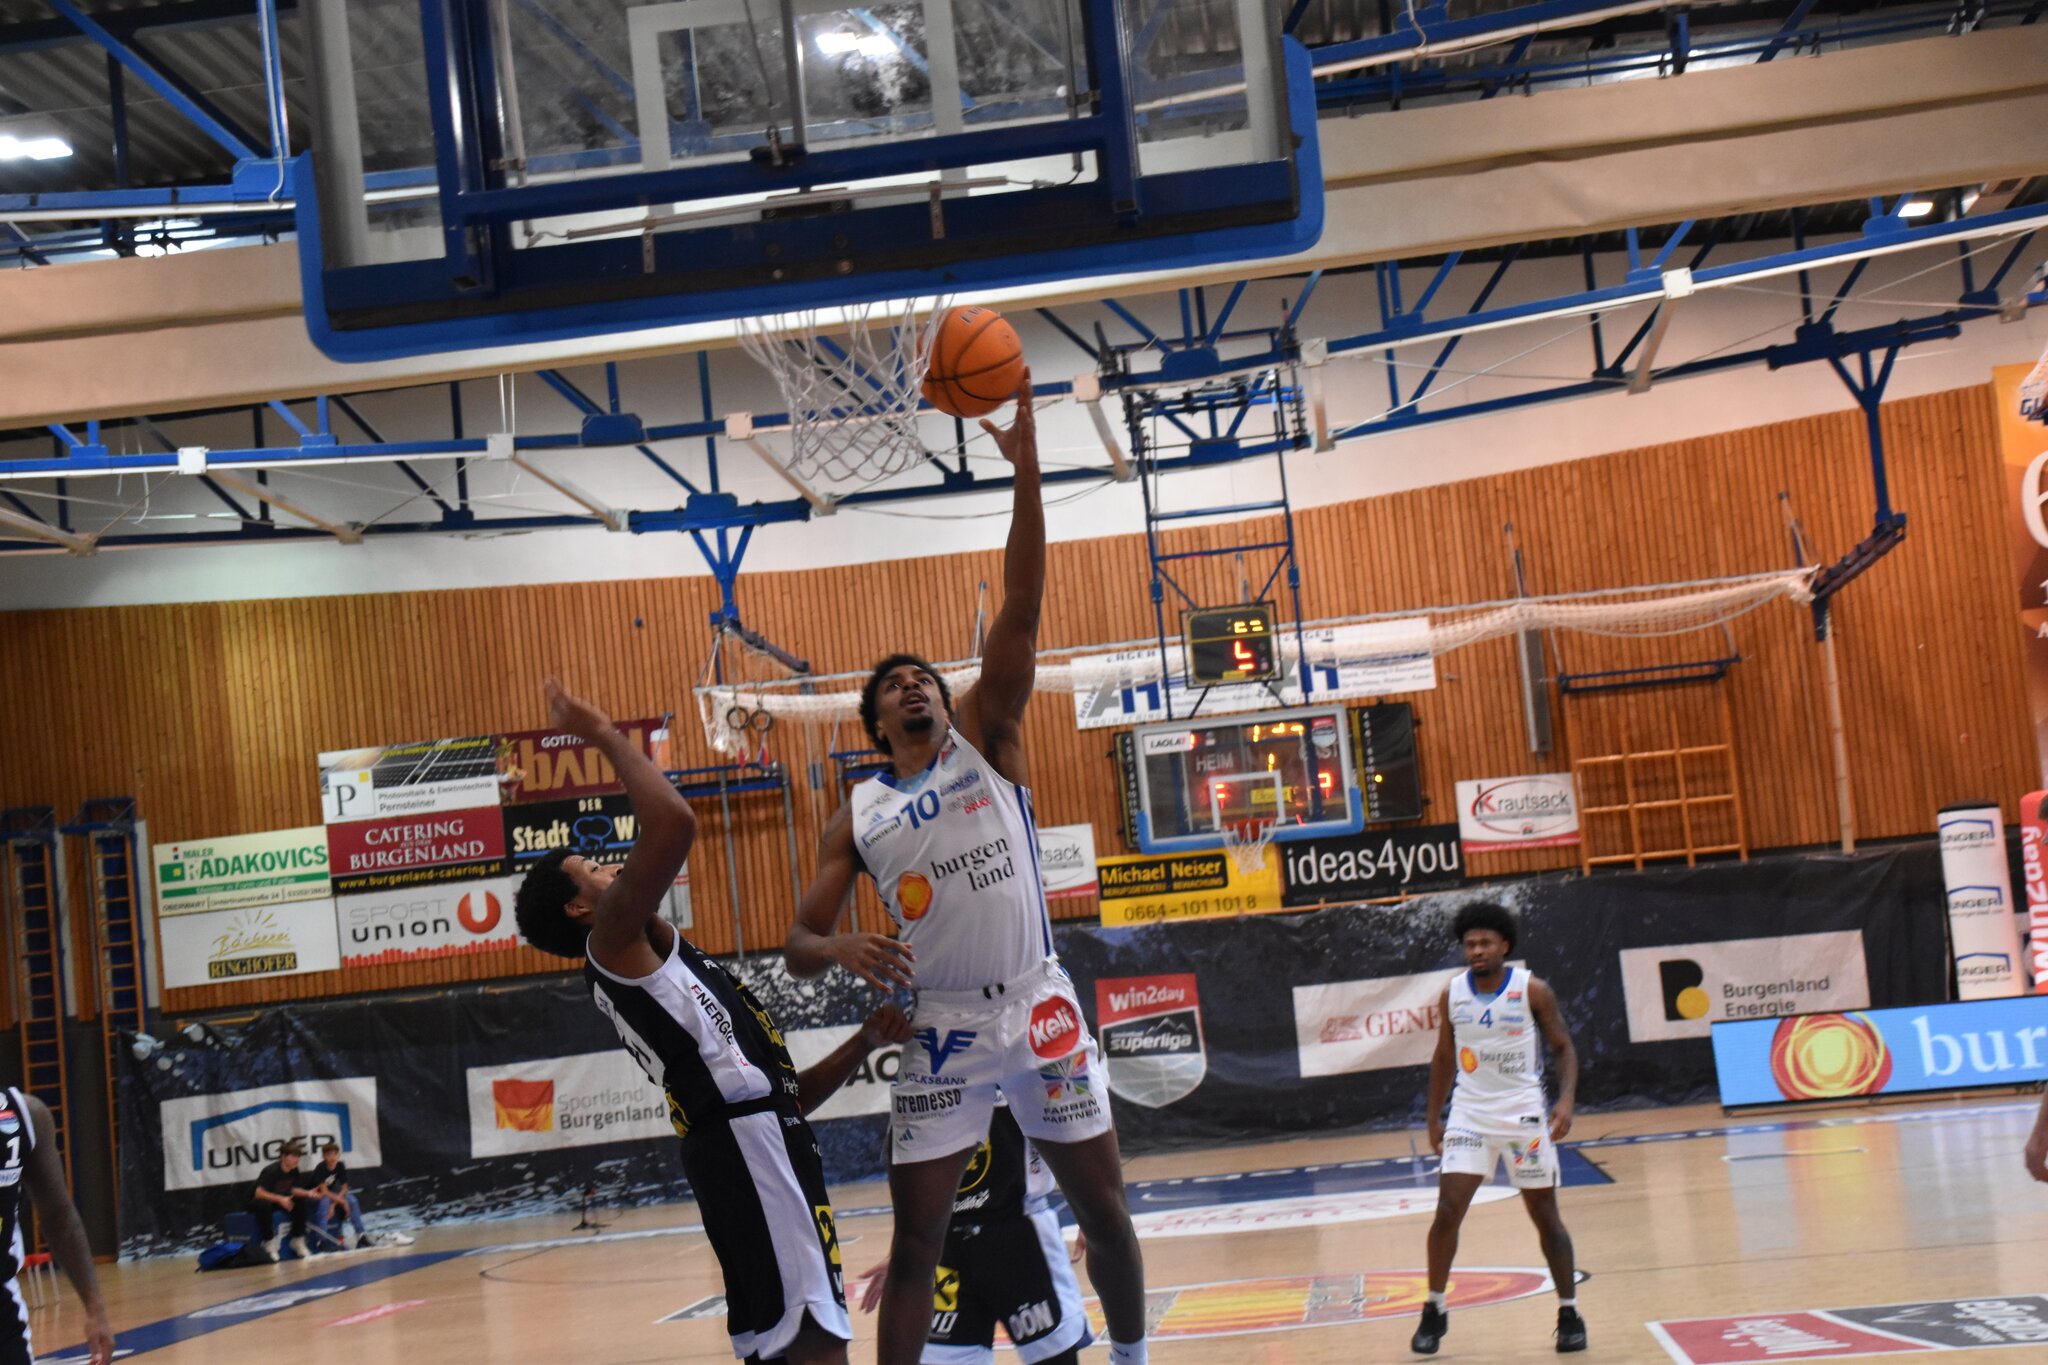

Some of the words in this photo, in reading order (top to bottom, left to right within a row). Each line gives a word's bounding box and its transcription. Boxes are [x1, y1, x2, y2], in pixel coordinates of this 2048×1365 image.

[1196, 751, 1234, 773] HEIM
[335, 784, 357, 817] P
[379, 799, 436, 813] Pernsteiner
[578, 797, 603, 812] DER
[901, 788, 941, 831] 10
[364, 818, 464, 846] CATERING
[512, 819, 571, 852] Stadt
[613, 814, 641, 842] W
[182, 847, 214, 860] MALER
[349, 840, 485, 870] BURGENLAND
[931, 836, 1009, 880] burgen
[1287, 838, 1460, 886] ideas4you
[338, 861, 500, 890] www.burgenland-catering.at
[968, 855, 1015, 893] land
[1101, 863, 1166, 886] Michael
[1170, 859, 1221, 879] Neiser
[350, 898, 448, 926] SPORT
[352, 917, 450, 944] union
[210, 953, 296, 978] RINGHOFER
[1722, 975, 1830, 1001] Burgenland
[1478, 1008, 1494, 1029] 4
[1725, 998, 1796, 1017] Energie
[1030, 1004, 1075, 1049] Keli
[1110, 1032, 1193, 1053] superliga
[903, 1070, 968, 1086] VOLKSBANK
[557, 1085, 645, 1114] Sportland
[895, 1087, 963, 1114] cremesso
[1042, 1097, 1099, 1115] FARBEN
[559, 1102, 666, 1130] Burgenland
[1042, 1107, 1102, 1124] PARTNER
